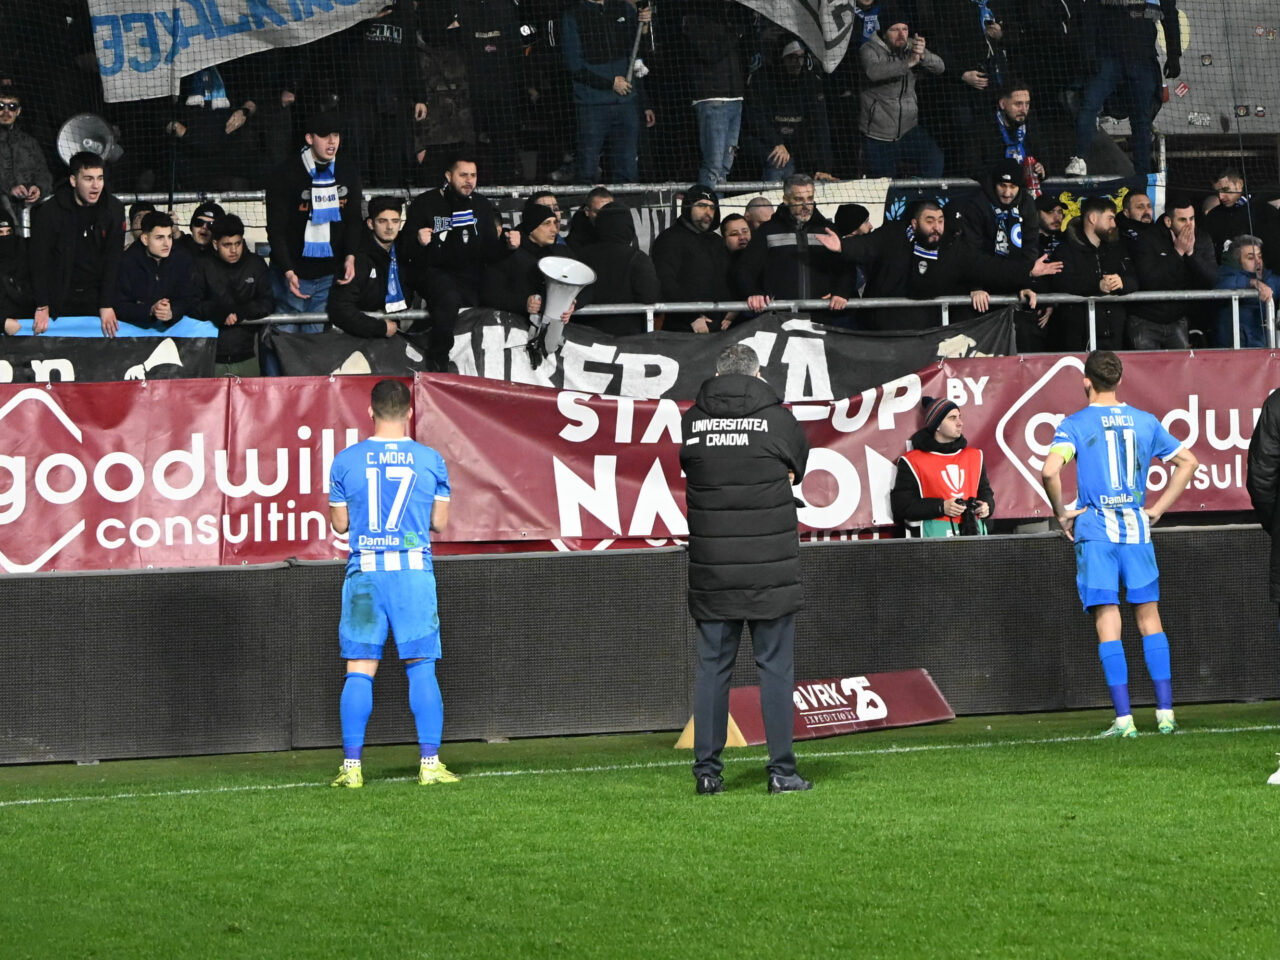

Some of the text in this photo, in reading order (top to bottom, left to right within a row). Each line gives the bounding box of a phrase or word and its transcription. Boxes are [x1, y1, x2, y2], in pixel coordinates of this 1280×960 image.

[946, 376, 990, 407] BY
[691, 418, 769, 433] UNIVERSITATEA
[1101, 415, 1134, 428] BANCU
[706, 433, 750, 447] CRAIOVA
[379, 451, 414, 465] MORA
[1105, 428, 1137, 490] 11
[366, 466, 418, 533] 17
[1100, 493, 1134, 505] Damila
[358, 535, 400, 546] Damila
